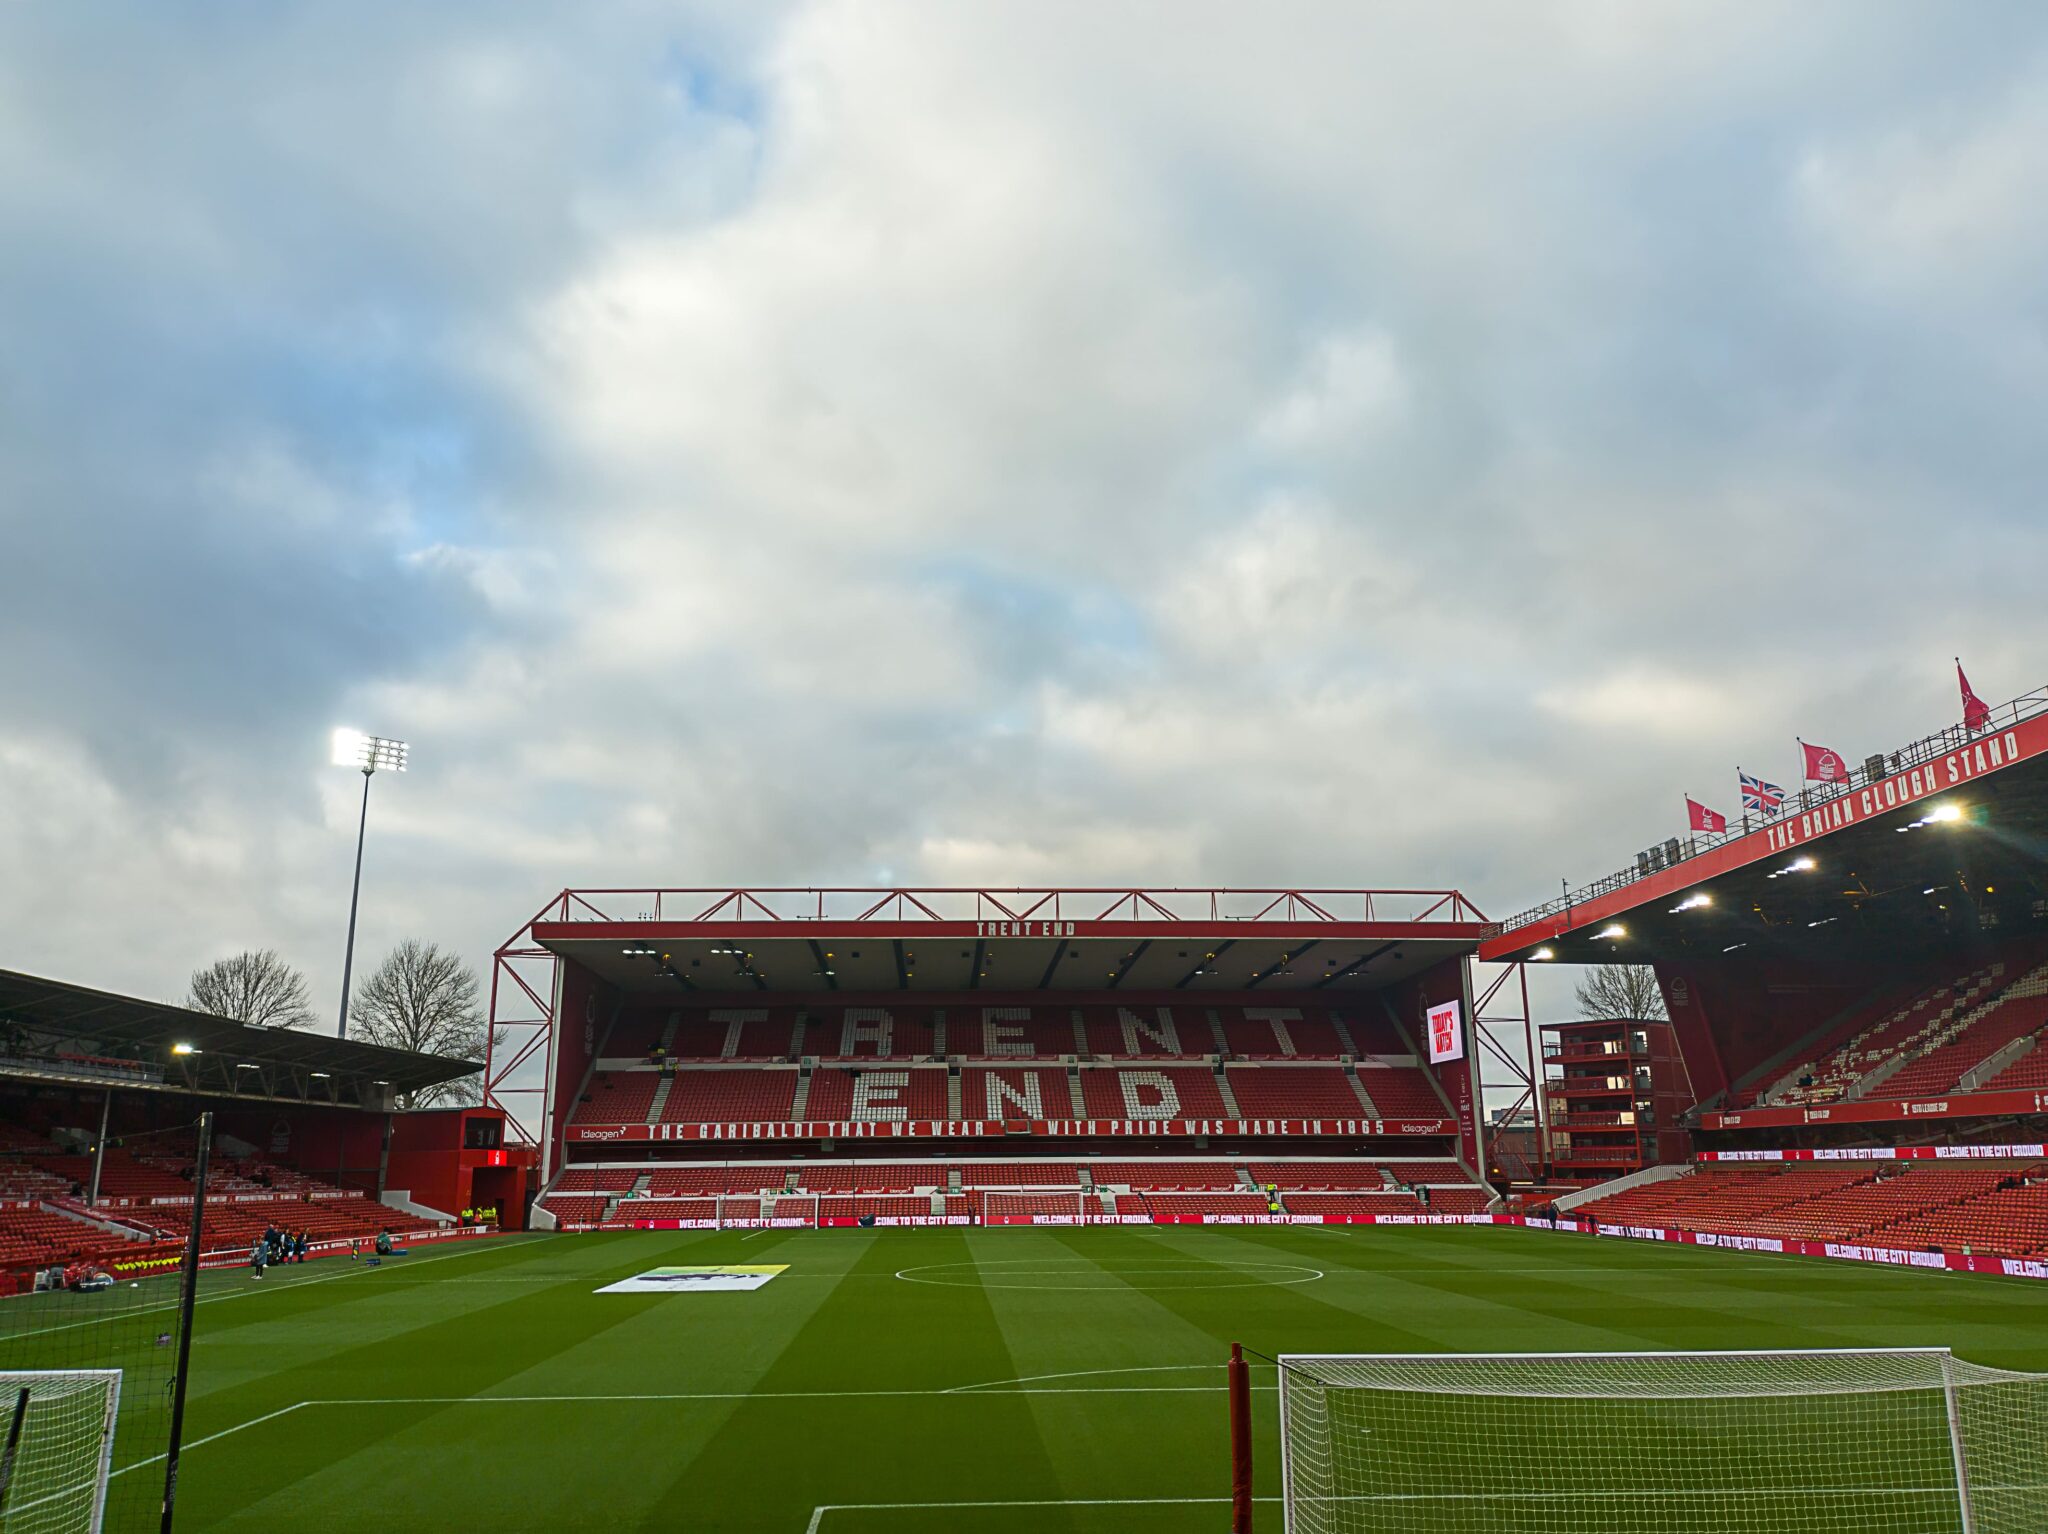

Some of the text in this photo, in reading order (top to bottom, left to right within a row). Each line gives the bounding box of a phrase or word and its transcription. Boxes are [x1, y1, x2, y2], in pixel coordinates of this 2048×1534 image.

[1767, 731, 2018, 851] THE BRIAN CLOUGH STAND
[977, 922, 1075, 936] TRENT END
[581, 1129, 619, 1140] Ideagen
[649, 1120, 1384, 1139] THE GARIBALDI THAT WE WEAR WITH PRIDE WAS MADE IN 1865
[1401, 1124, 1438, 1134] Ideagen
[1935, 1145, 2044, 1158] WELCOME TO THE CITY GROUND
[900, 1217, 910, 1225] TO
[911, 1217, 926, 1225] THE
[928, 1216, 946, 1225] CITY
[948, 1215, 980, 1225] GROUD
[1033, 1215, 1074, 1224] WELCOME
[1102, 1215, 1121, 1224] CITY
[1244, 1215, 1255, 1224] TO
[1256, 1215, 1271, 1224] THE
[1272, 1215, 1290, 1224] CITY
[1291, 1215, 1323, 1224] GROUND
[1375, 1215, 1493, 1224] WELCOME TO THE CITY GROUND
[1723, 1235, 1731, 1247] TO
[1743, 1237, 1757, 1249] CITY
[1757, 1238, 1783, 1252] GROUND
[1825, 1243, 1946, 1268] WELCOME TO THE CITY GROUND
